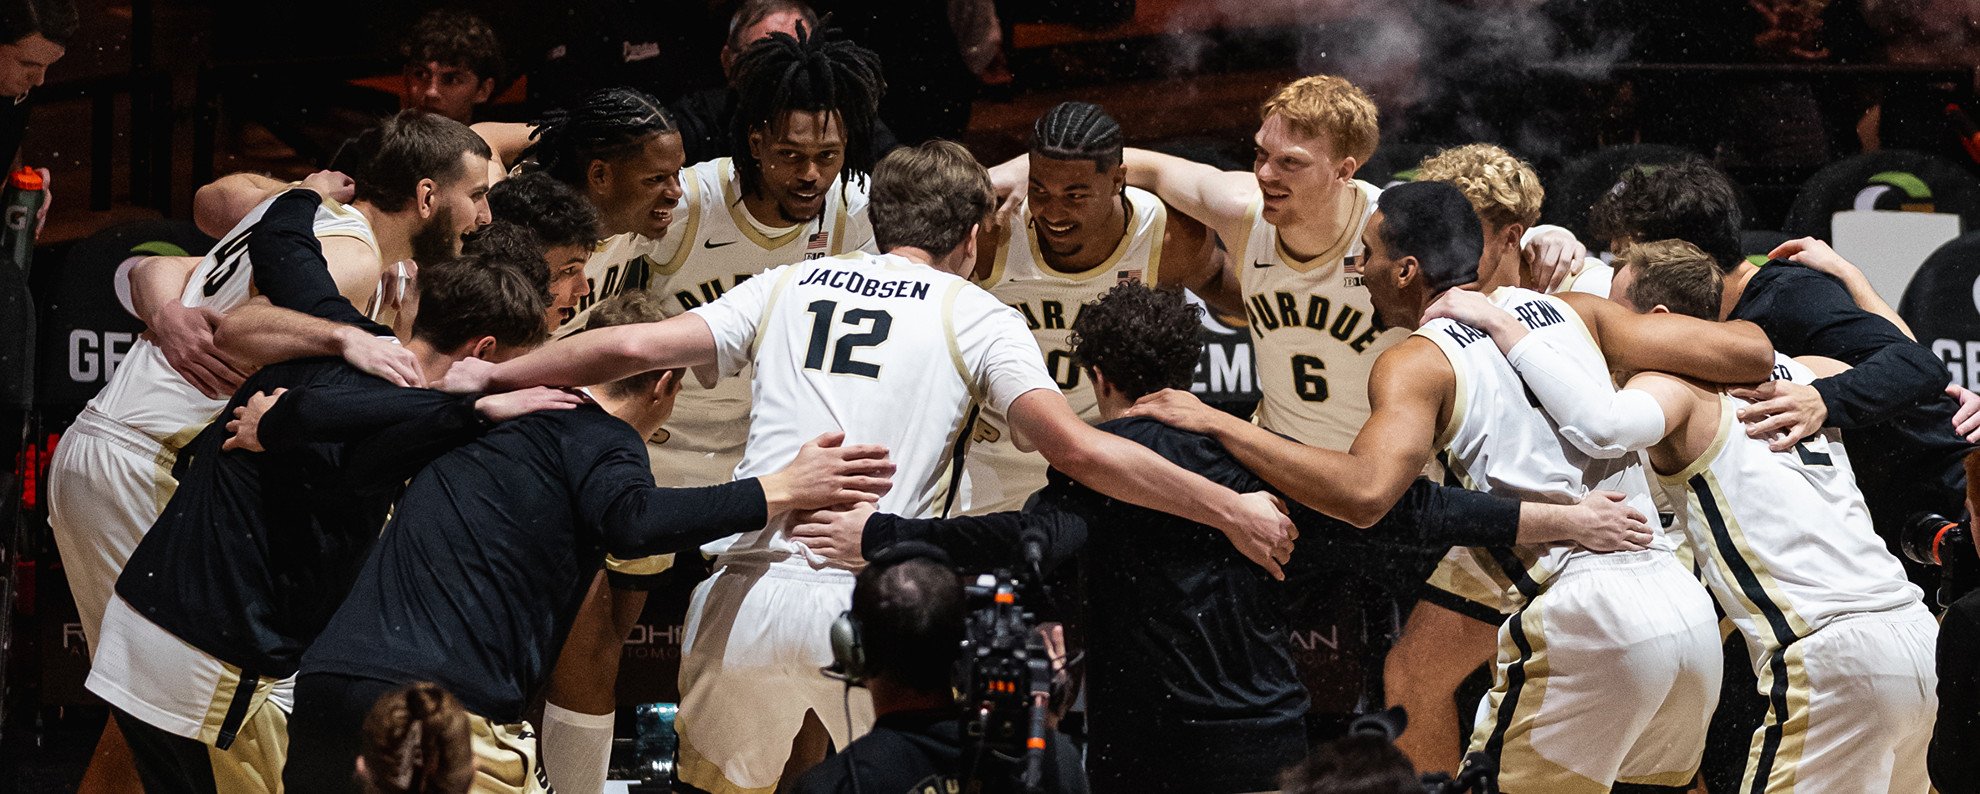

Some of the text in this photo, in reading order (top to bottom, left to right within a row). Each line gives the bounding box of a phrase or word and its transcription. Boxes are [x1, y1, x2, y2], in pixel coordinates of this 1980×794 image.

[799, 268, 931, 300] JACOBSEN
[803, 300, 893, 379] 12
[1291, 354, 1329, 402] 6
